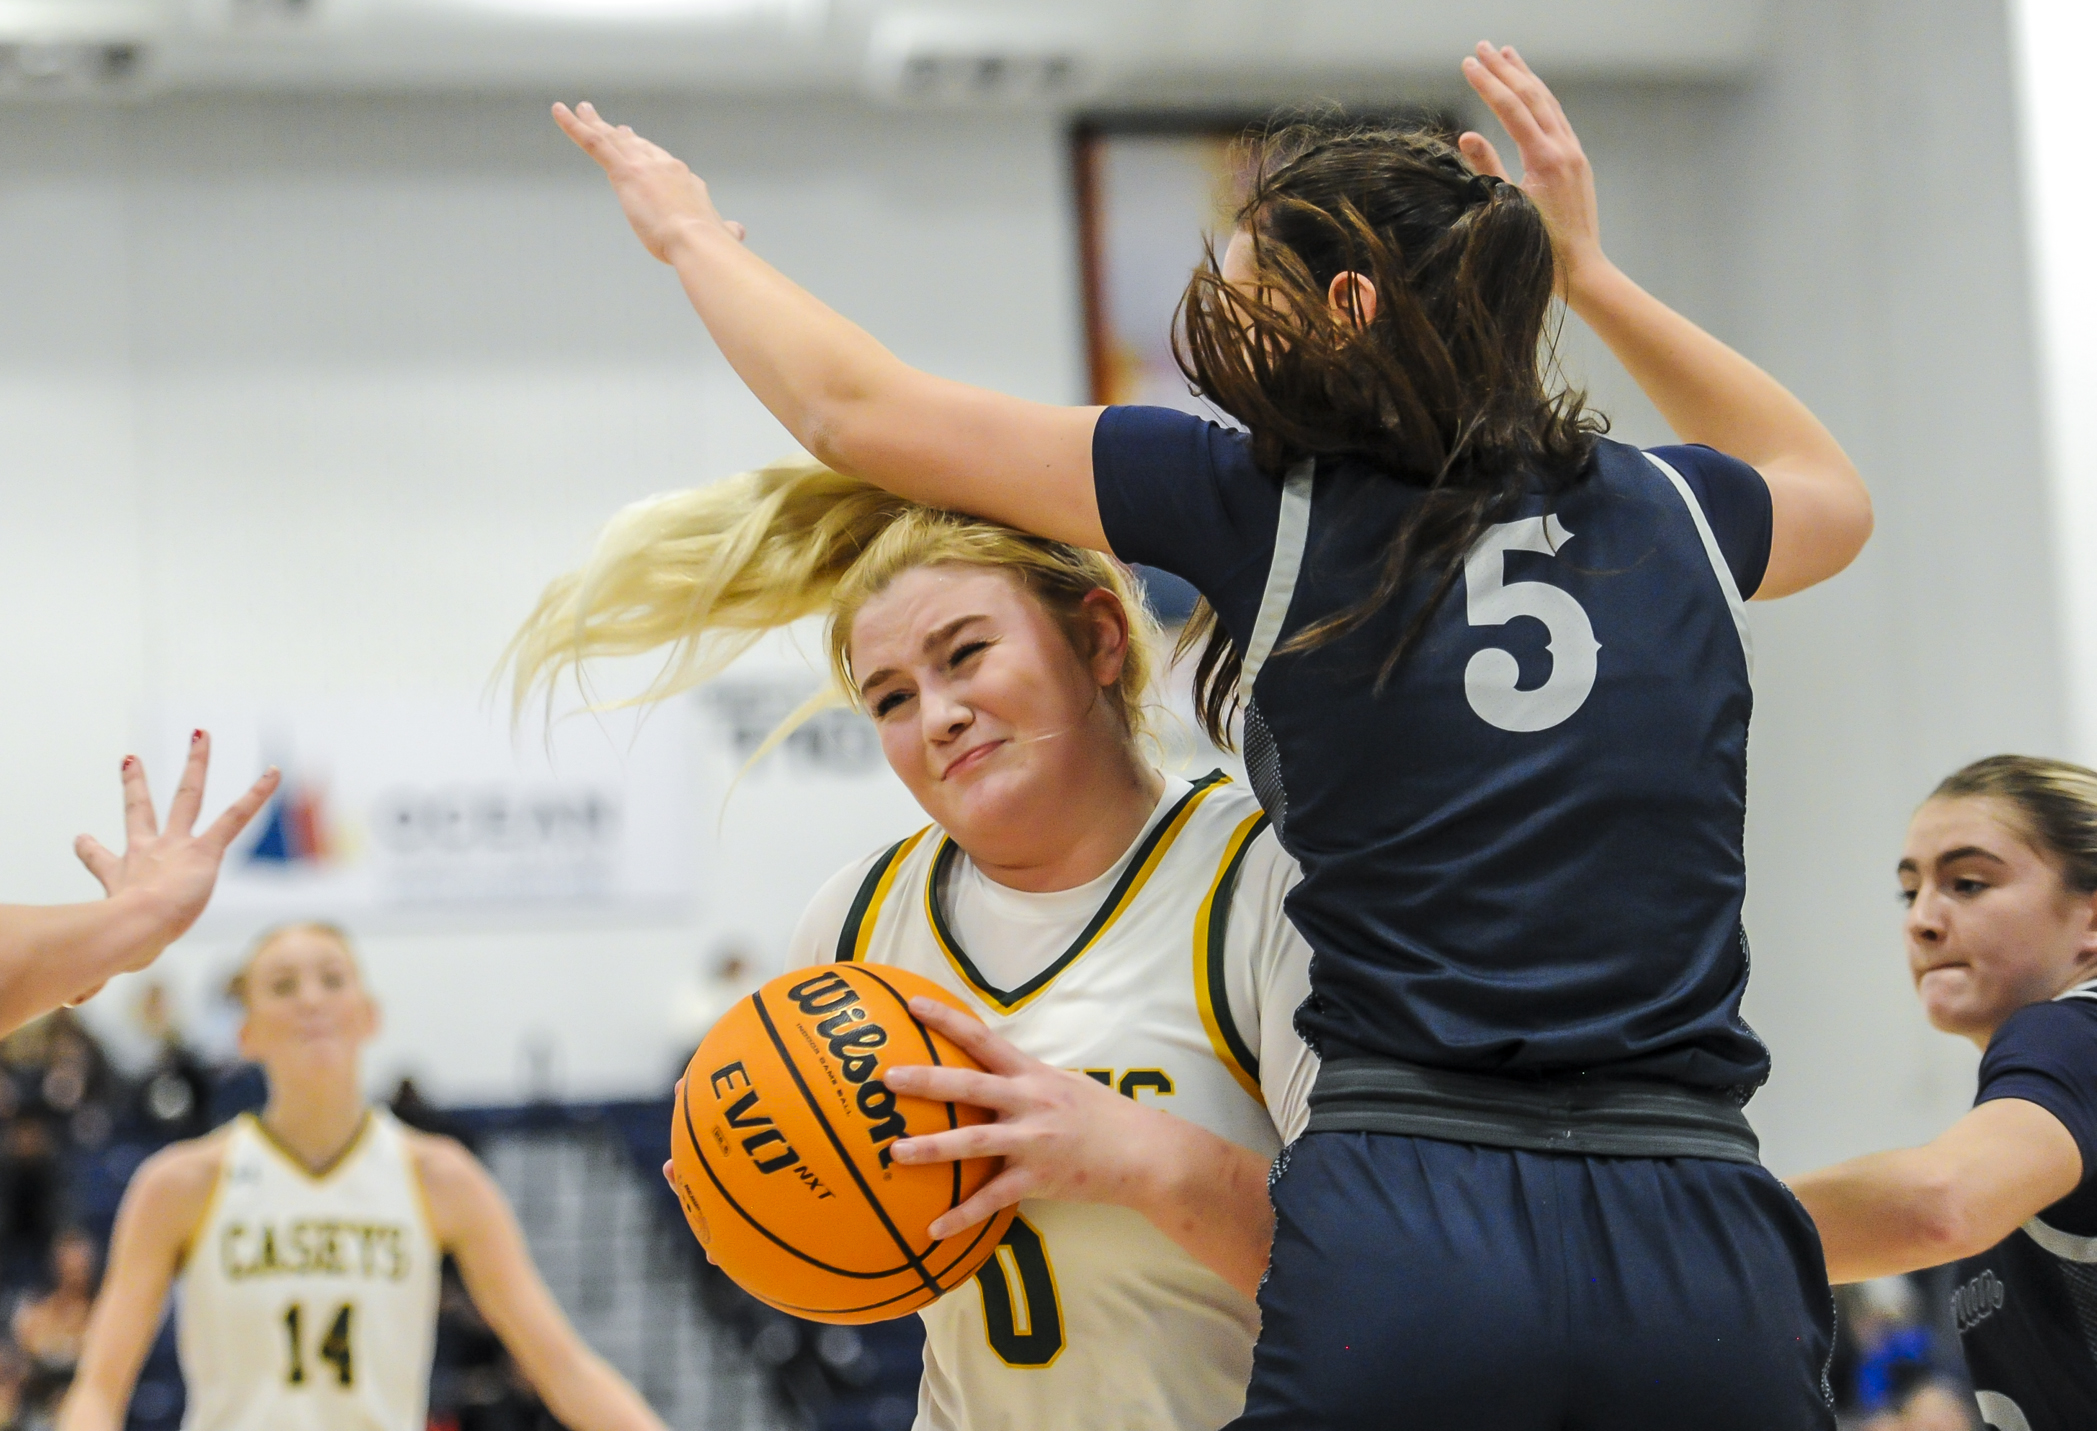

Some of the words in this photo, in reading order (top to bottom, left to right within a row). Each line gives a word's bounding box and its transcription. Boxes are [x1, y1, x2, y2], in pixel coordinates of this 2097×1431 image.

[1463, 513, 1603, 733] 5
[787, 970, 912, 1171] Wilson
[796, 1023, 820, 1055] INDOOR
[819, 1057, 838, 1086] GAME
[836, 1089, 852, 1118] BALL
[710, 1060, 801, 1175] EVO
[793, 1165, 837, 1201] NXT
[220, 1219, 410, 1283] CASEYS
[283, 1302, 354, 1388] 14
